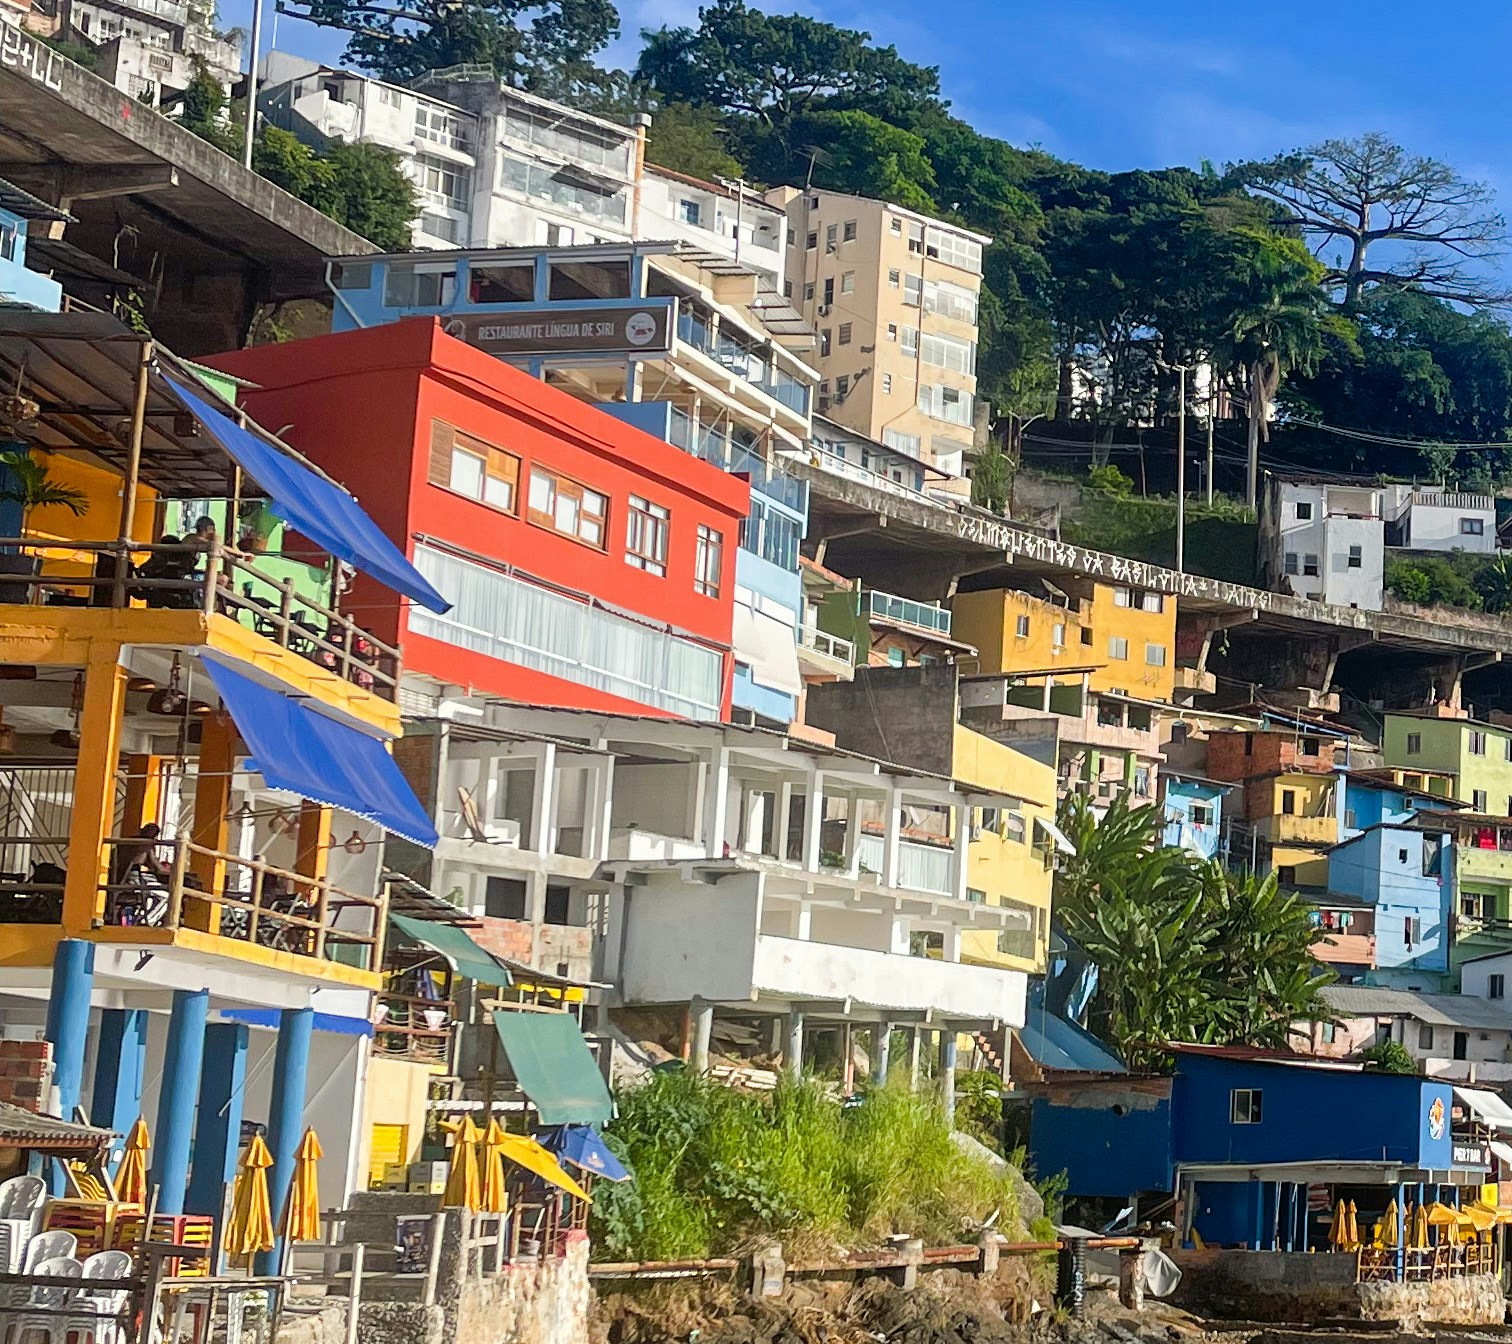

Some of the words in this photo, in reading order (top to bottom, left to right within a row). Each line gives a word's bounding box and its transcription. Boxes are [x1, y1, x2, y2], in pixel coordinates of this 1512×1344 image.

[478, 325, 544, 340] RESTAURANTE
[545, 321, 579, 338] LÍNGUA
[582, 323, 594, 337] DE
[596, 322, 615, 336] SIRI
